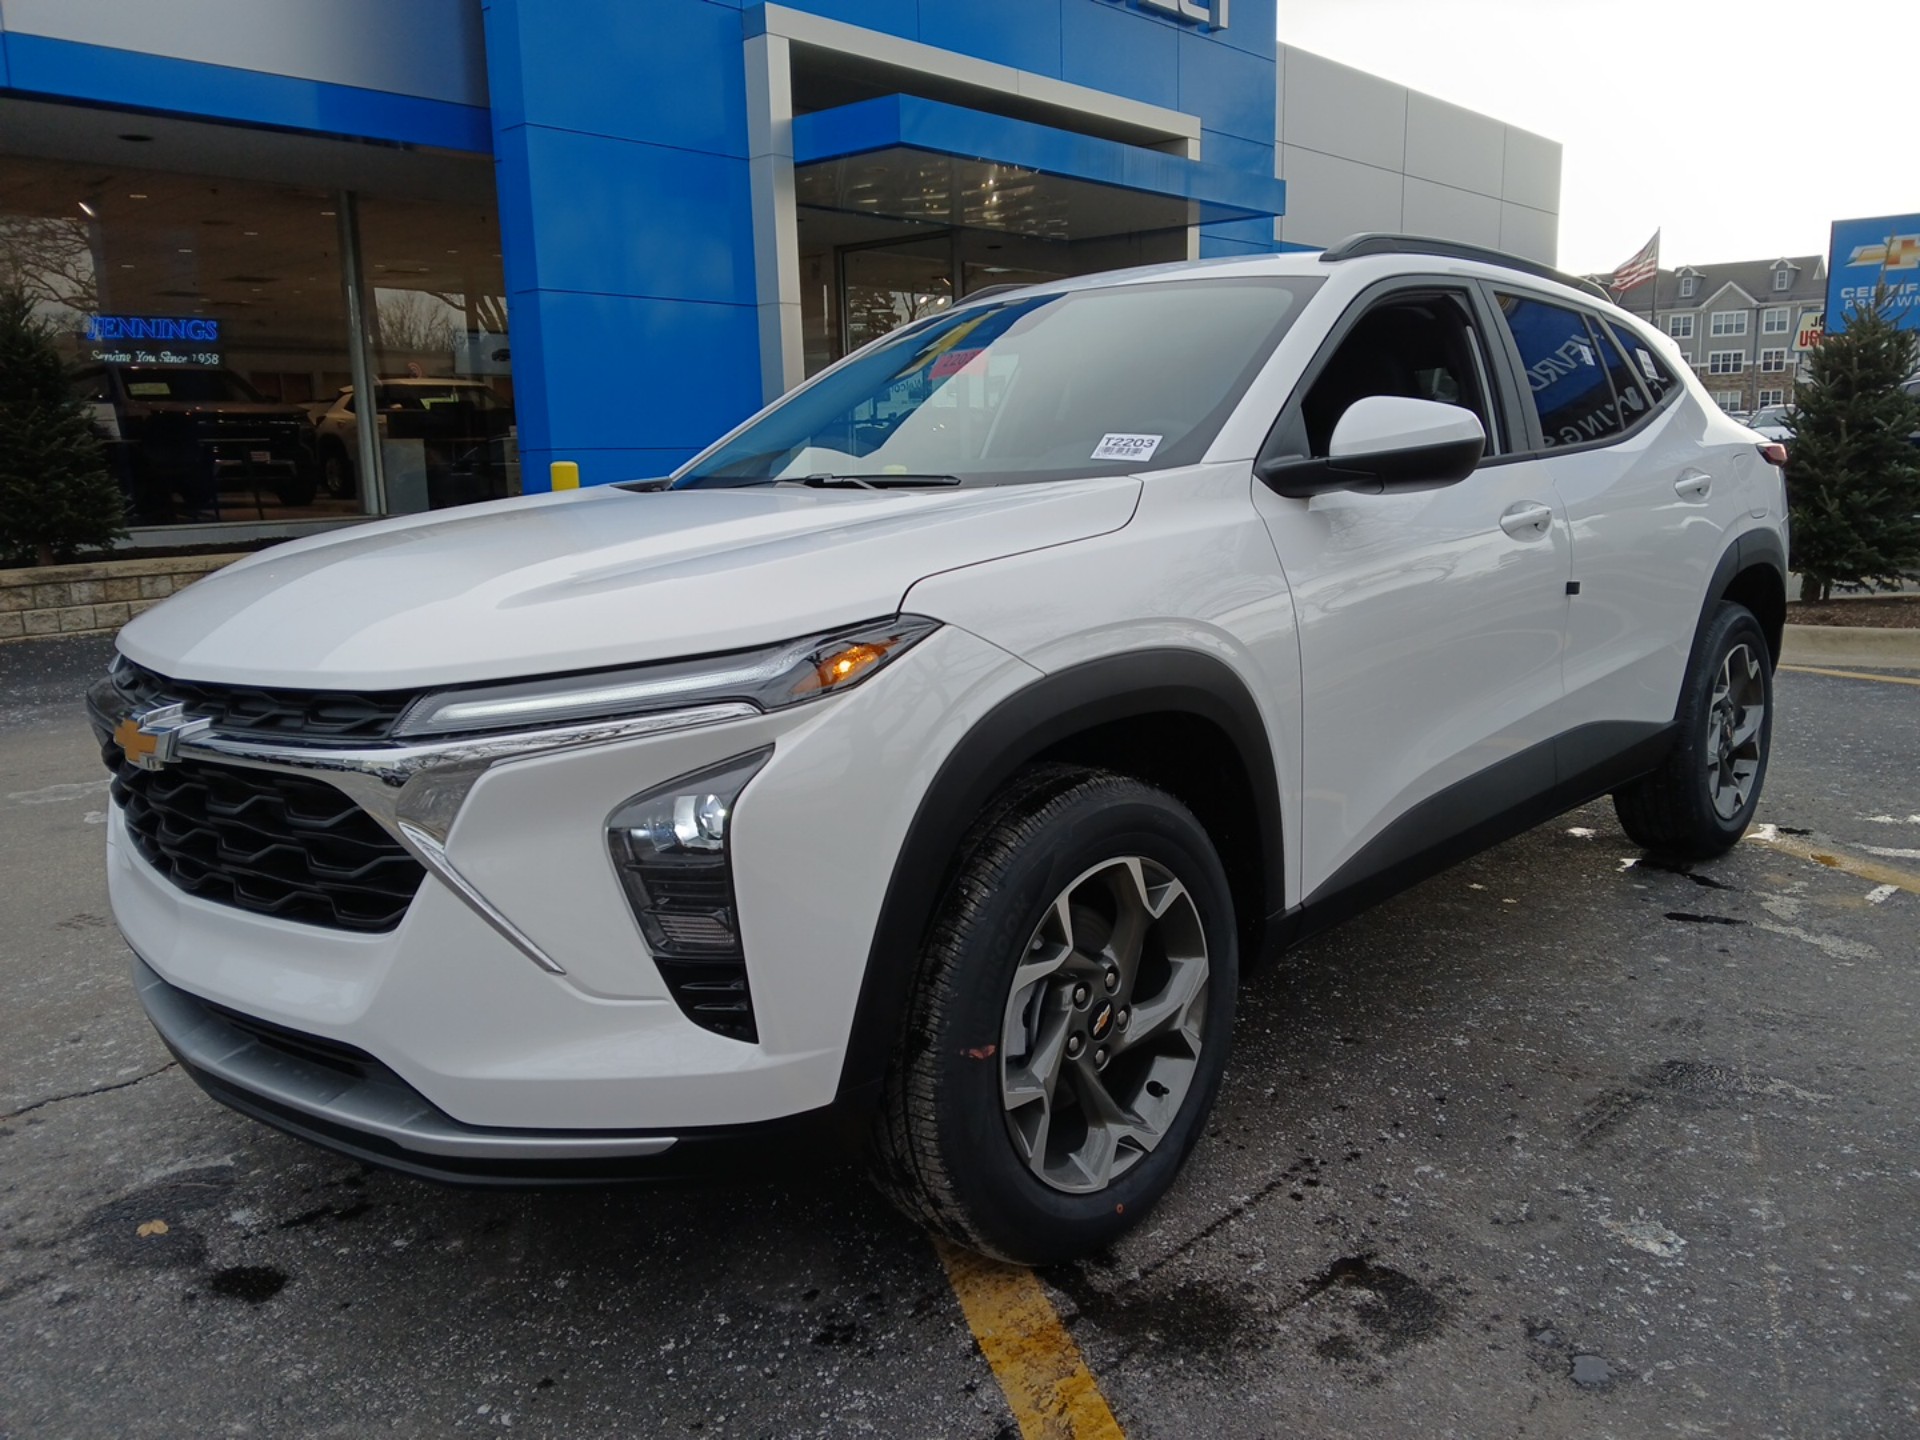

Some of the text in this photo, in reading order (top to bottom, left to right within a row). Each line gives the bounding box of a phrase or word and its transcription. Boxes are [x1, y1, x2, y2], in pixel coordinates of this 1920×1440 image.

[87, 317, 218, 340] JENNINGS
[136, 351, 155, 362] You
[160, 351, 188, 363] Since
[192, 353, 219, 365] 1958
[1105, 437, 1155, 448] T2203
